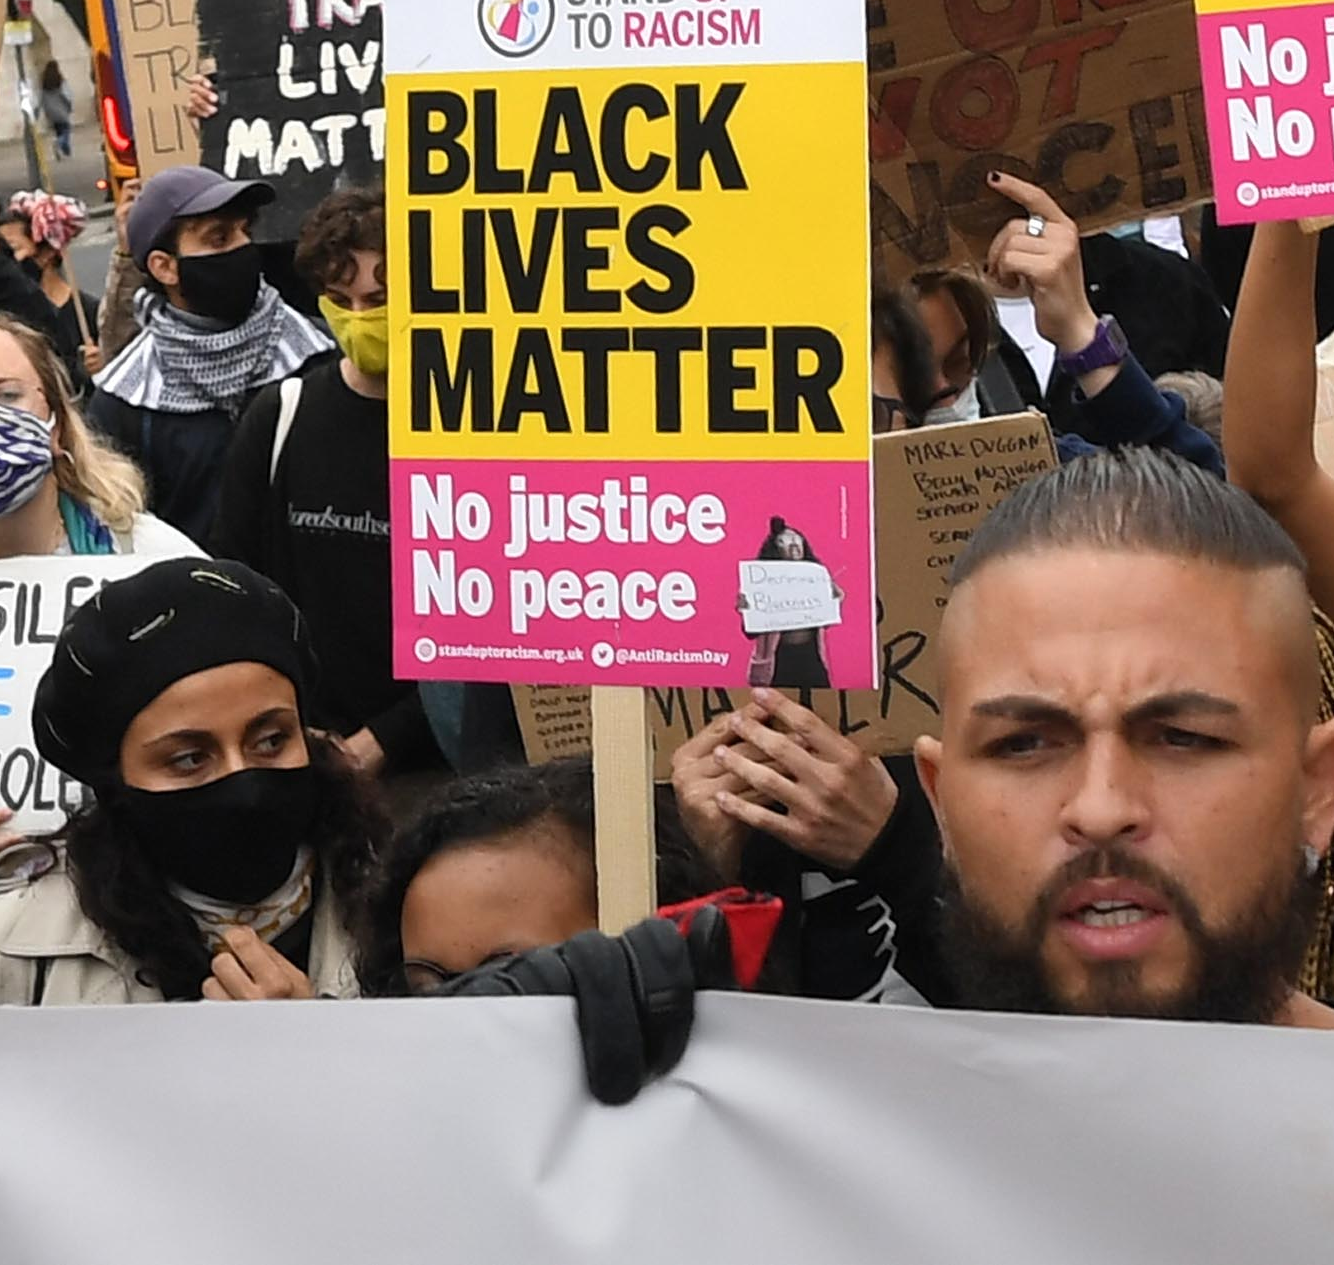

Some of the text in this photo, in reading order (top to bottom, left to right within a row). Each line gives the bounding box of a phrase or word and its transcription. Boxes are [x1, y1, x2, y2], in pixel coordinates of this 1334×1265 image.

[568, 9, 761, 49] TO RACISM
[1219, 23, 1309, 88] No
[148, 105, 200, 156] LI
[408, 83, 749, 195] BLACK
[1227, 95, 1315, 162] No
[408, 204, 695, 315] LIVES
[410, 326, 845, 434] MATTER
[904, 431, 1040, 465] MARK DUGGAN
[410, 474, 726, 558] No justice
[413, 550, 697, 634] No peace
[438, 642, 729, 667] standuptoracism.org.uk @AntiRacismDay
